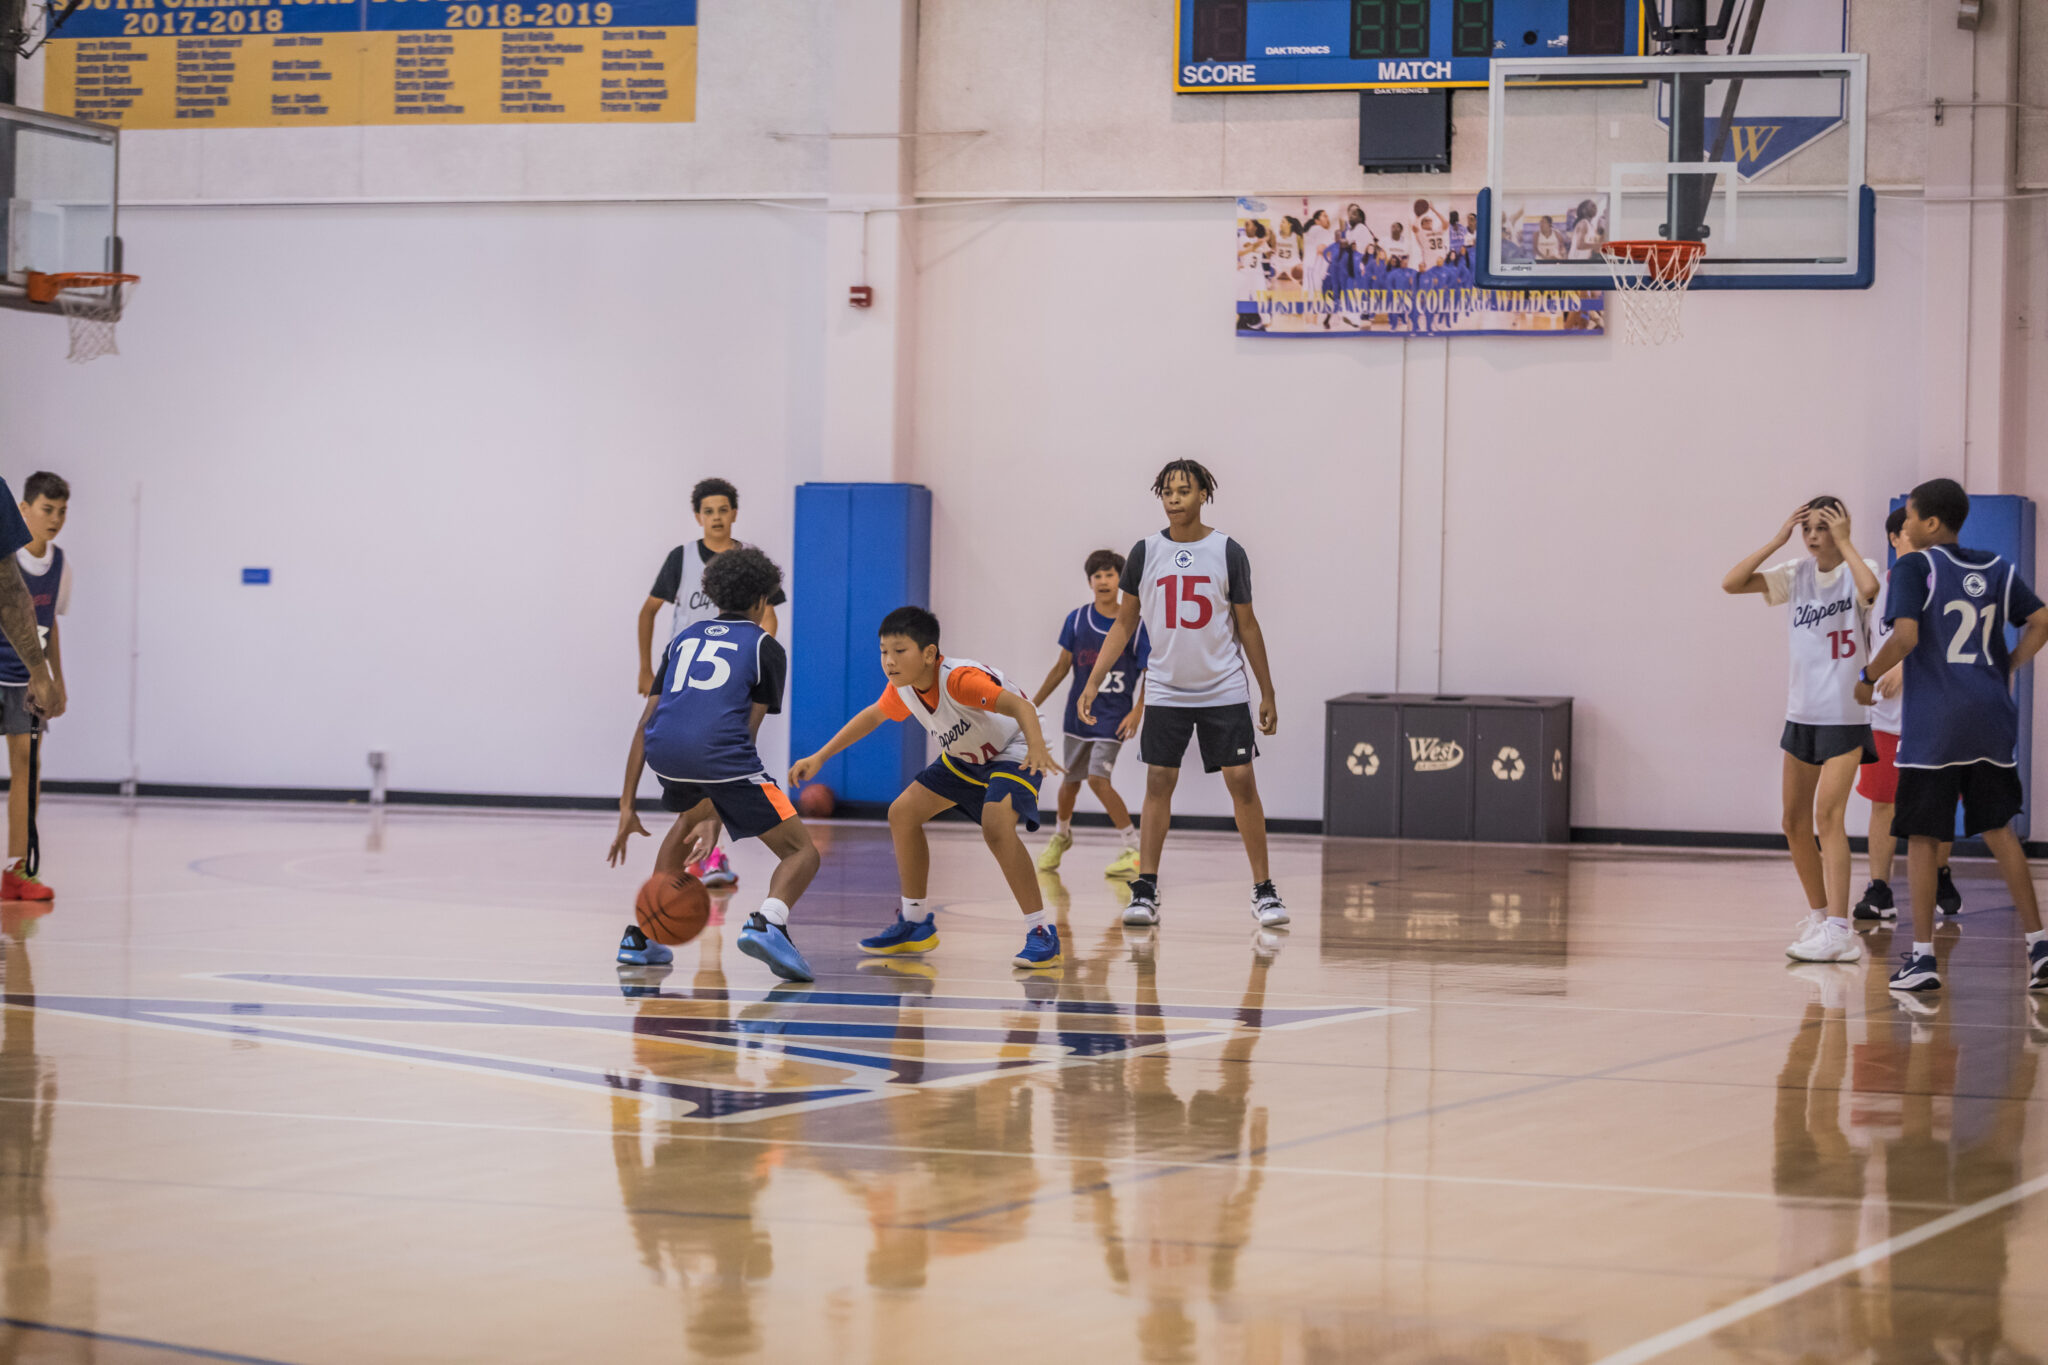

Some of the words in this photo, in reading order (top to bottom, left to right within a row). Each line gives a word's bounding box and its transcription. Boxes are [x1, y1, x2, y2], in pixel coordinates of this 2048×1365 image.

[123, 10, 284, 34] 2017-2018
[446, 3, 613, 28] 2018-2019
[1265, 46, 1330, 55] DAKTRONICS
[1183, 64, 1256, 84] SCORE
[1378, 61, 1452, 80] MATCH
[1731, 126, 1782, 162] W
[1340, 289, 1413, 314] ANGELES
[1415, 287, 1492, 314] COLLEGE
[1495, 289, 1582, 314] WILDCATS
[1157, 574, 1213, 629] 15
[1794, 597, 1852, 629] Clippers
[1827, 629, 1856, 659] 15
[1943, 600, 1997, 665] 21
[670, 638, 738, 692] 15
[1098, 671, 1125, 693] 23
[931, 719, 971, 751] ppers
[1408, 737, 1457, 761] West
